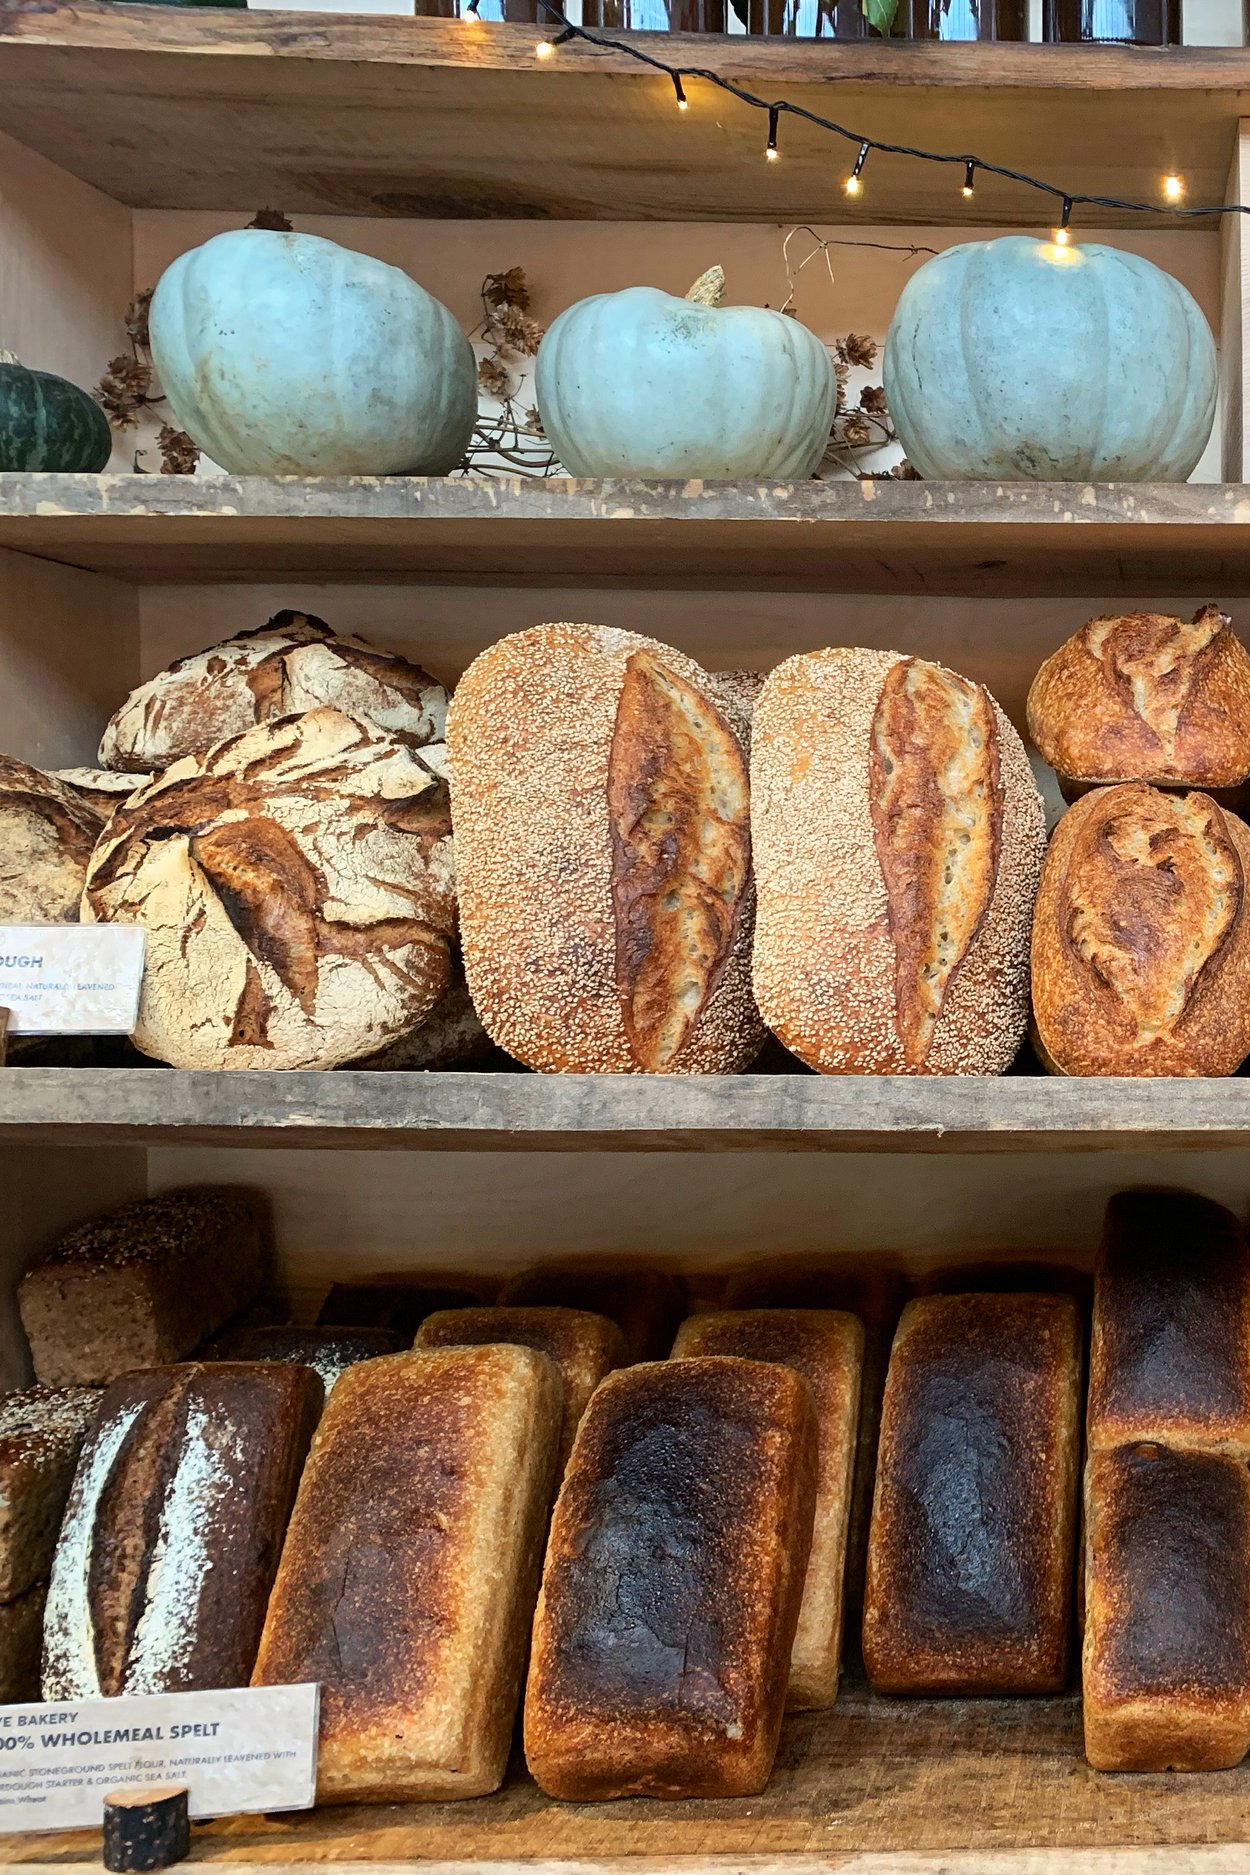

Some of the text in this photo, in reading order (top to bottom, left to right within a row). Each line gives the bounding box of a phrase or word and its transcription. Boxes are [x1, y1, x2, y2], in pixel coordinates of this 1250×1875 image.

[0, 1712, 79, 1727] E BAKERY
[41, 1726, 164, 1748] WHOLEMEAL
[169, 1722, 220, 1739] SPELT
[0, 1769, 26, 1778] ANIC
[29, 1763, 105, 1776] STONEGROUND
[108, 1762, 132, 1771] SPELT
[169, 1756, 221, 1767] NATURALLY
[223, 1752, 271, 1764] LEAVENED
[272, 1750, 297, 1760] WITH
[45, 1779, 83, 1789] STARTER
[86, 1777, 94, 1785] &
[96, 1774, 142, 1785] ORGANIC
[145, 1773, 163, 1781] SEA
